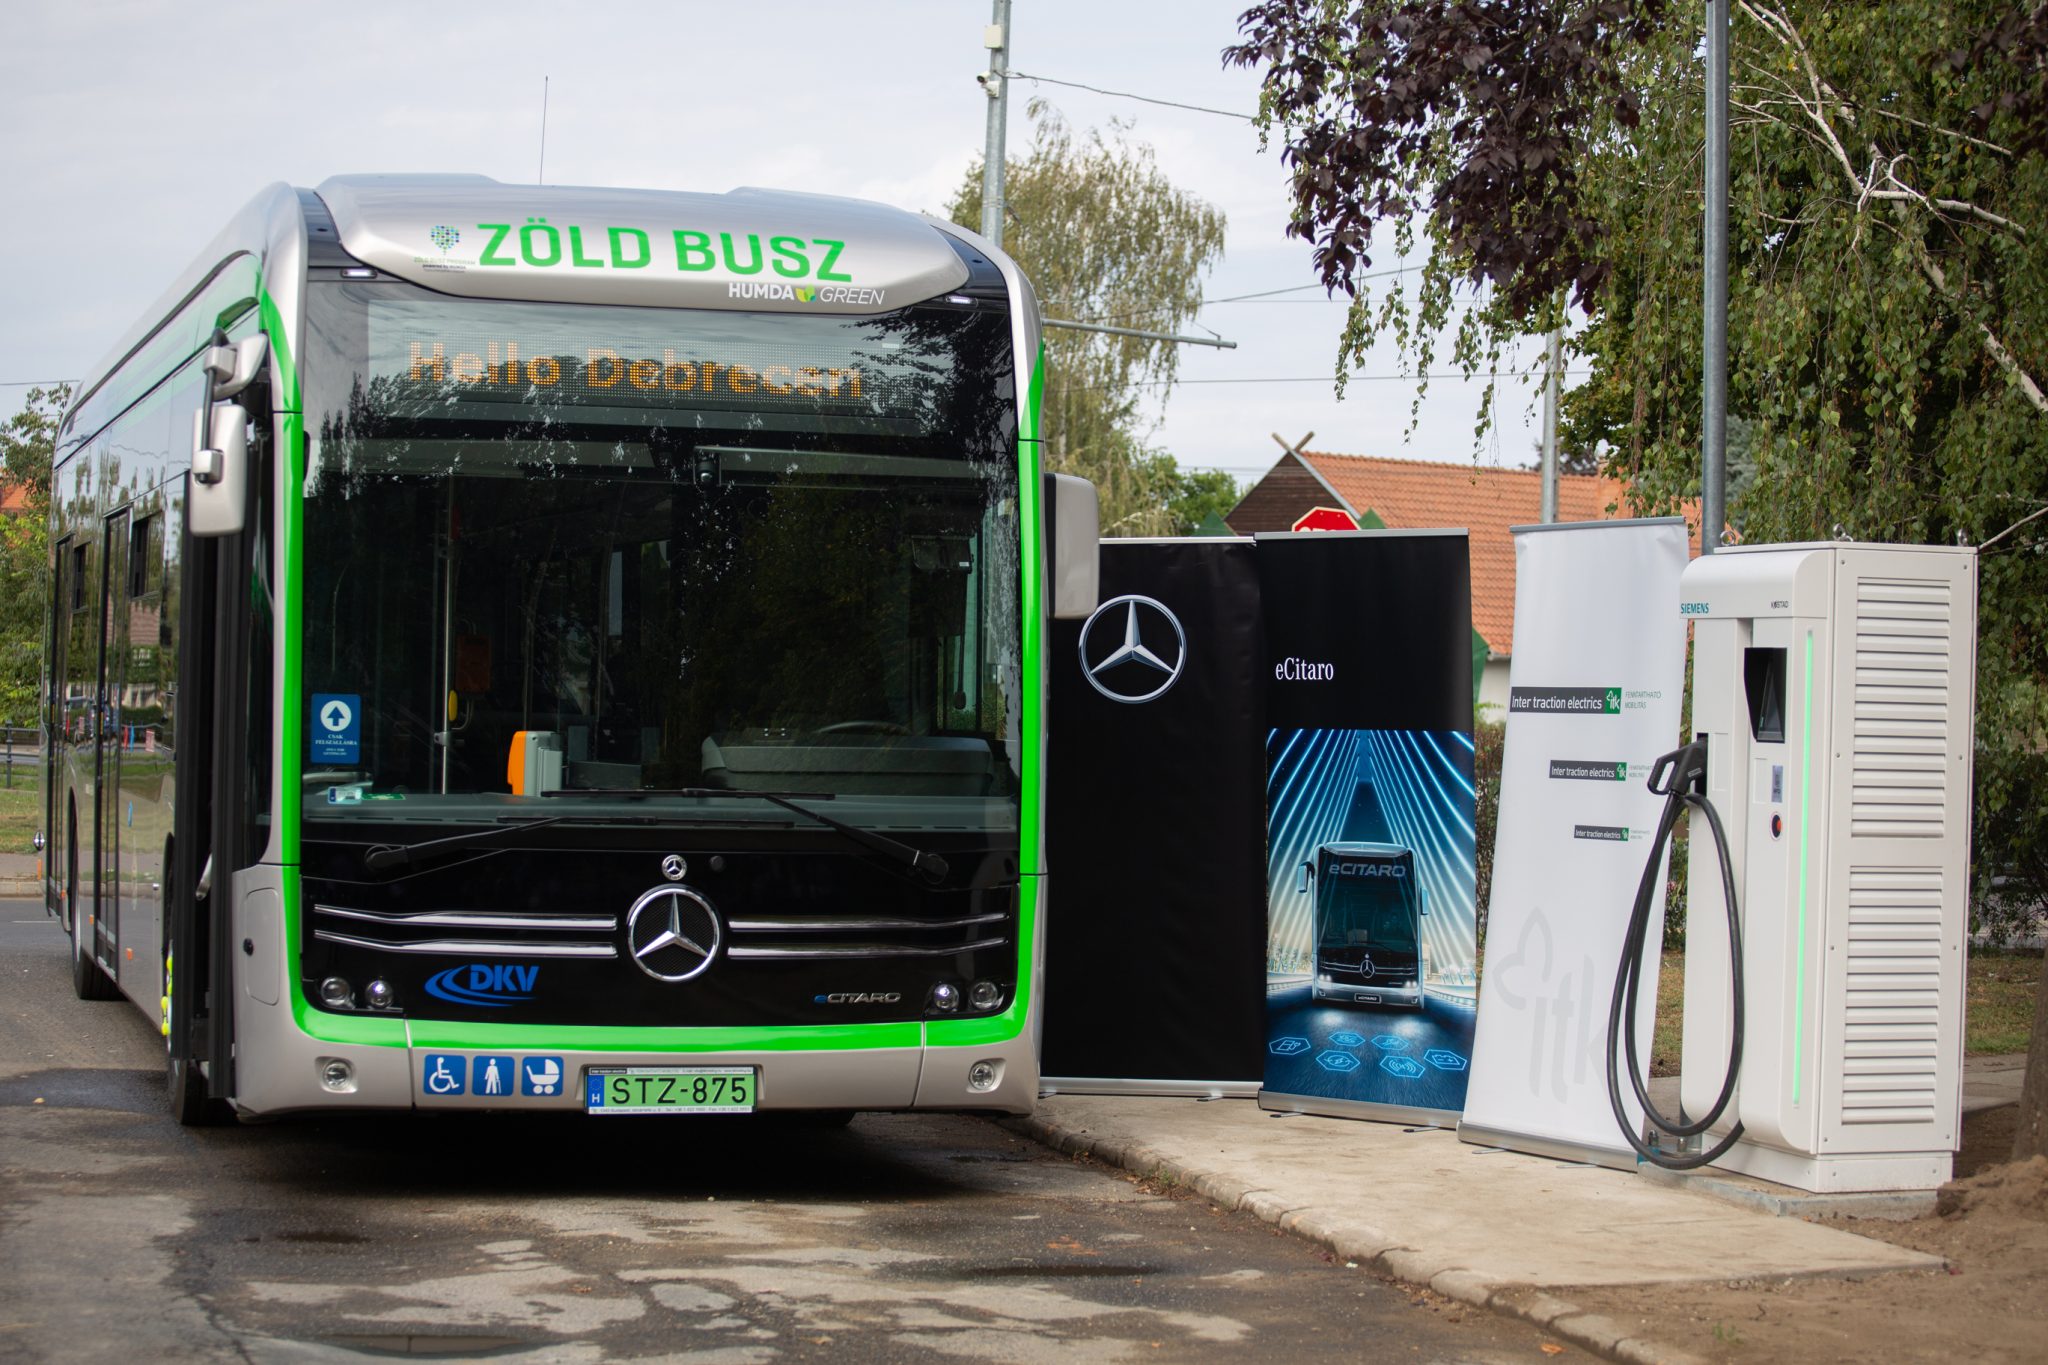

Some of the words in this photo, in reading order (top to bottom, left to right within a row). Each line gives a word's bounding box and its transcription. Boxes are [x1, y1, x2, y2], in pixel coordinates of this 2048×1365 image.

[476, 217, 652, 269] ZÖLD
[672, 230, 853, 283] BUSZ
[728, 282, 795, 301] HUMDA
[819, 286, 885, 305] GREEN
[410, 341, 561, 386] Hello
[587, 348, 862, 398] Debrecen
[1680, 603, 1709, 614] SIEMENS
[1275, 657, 1334, 681] eCitaro
[1511, 695, 1532, 708] Inter
[1533, 696, 1566, 709] traction
[1567, 696, 1603, 710] electrics
[1551, 766, 1566, 776] Inter
[1566, 766, 1589, 777] traction
[1589, 767, 1615, 778] electrics
[1328, 862, 1407, 877] eCITARO
[469, 964, 540, 992] DKV
[814, 992, 901, 1004] eCITARO
[591, 1093, 600, 1104] H
[611, 1077, 747, 1104] STZ-875
